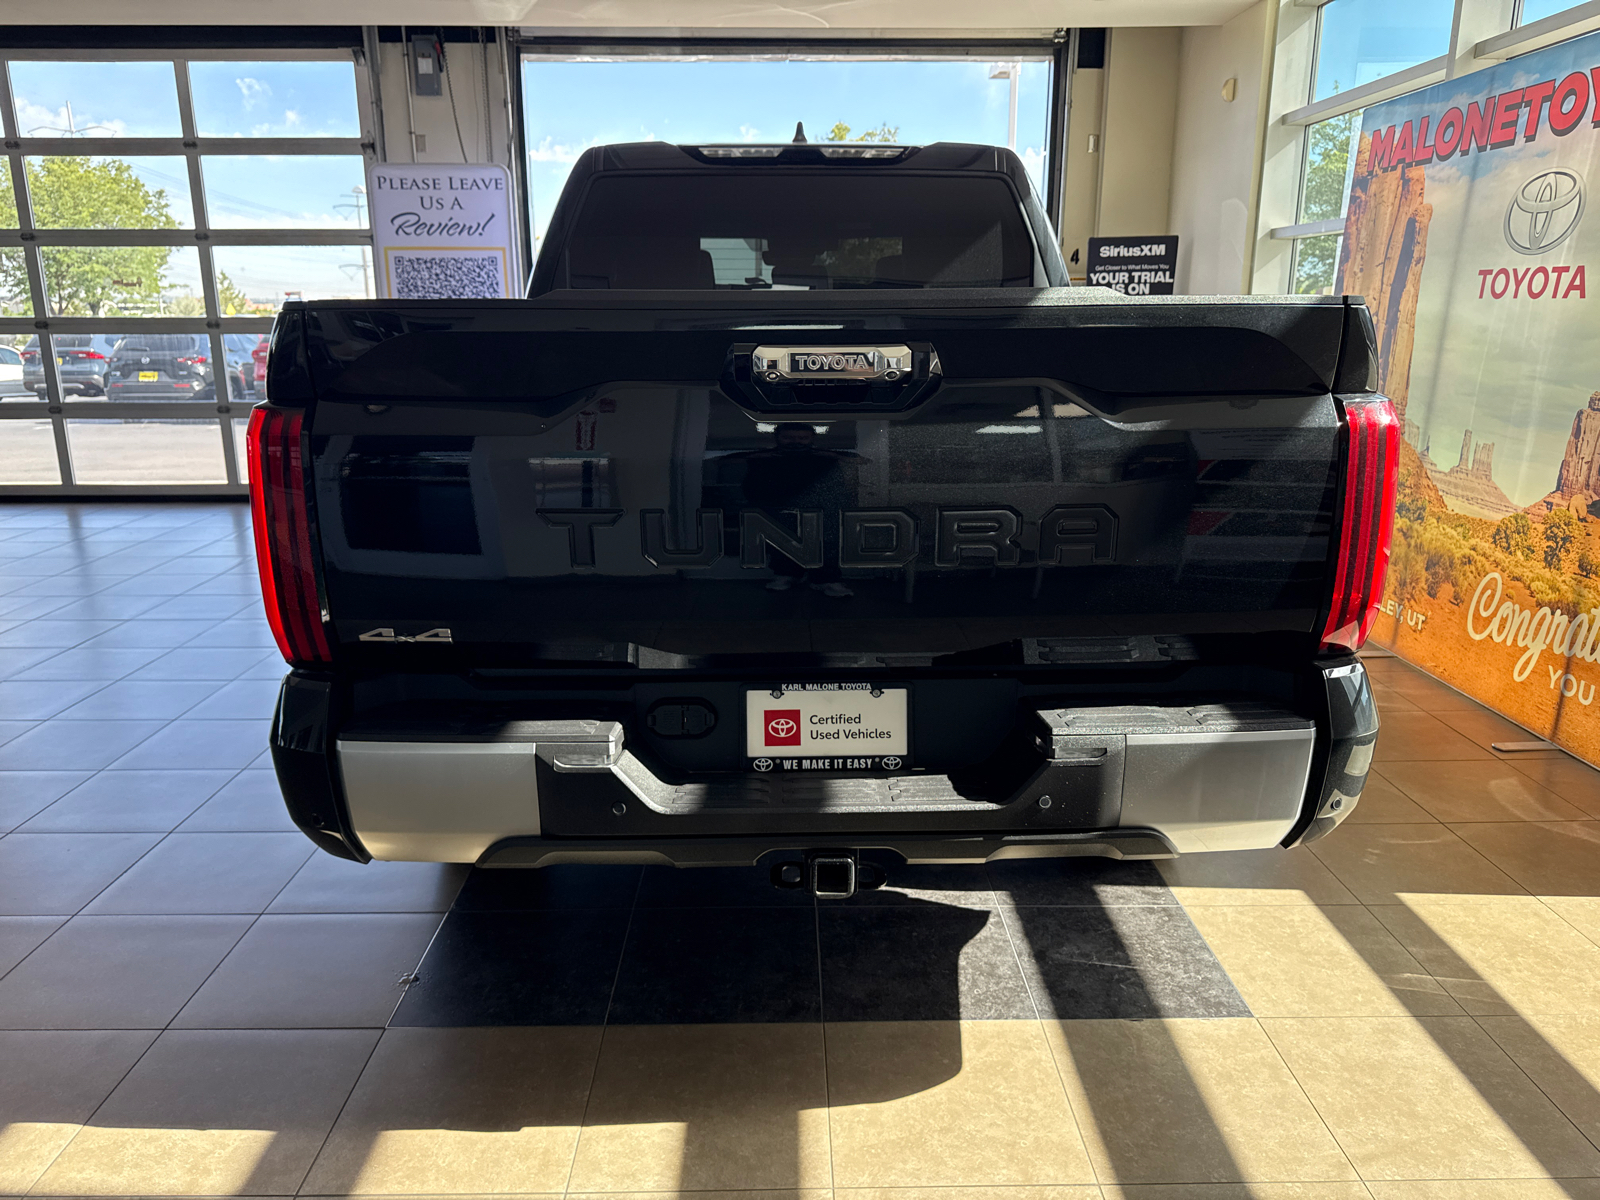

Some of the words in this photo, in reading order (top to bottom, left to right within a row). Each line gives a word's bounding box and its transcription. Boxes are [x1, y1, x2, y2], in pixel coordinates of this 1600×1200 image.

[1366, 66, 1600, 176] MALONETO
[376, 175, 442, 191] PLEASE
[448, 176, 504, 191] LEAVE
[419, 195, 445, 210] US
[450, 196, 465, 210] A
[390, 211, 496, 237] Review!
[1071, 249, 1079, 264] 4
[1100, 244, 1165, 257] SiriusXM
[1089, 271, 1130, 284] YOUR
[1131, 270, 1174, 284] TRIAL
[1478, 265, 1586, 300] TOYOTA
[1127, 283, 1151, 295] ON
[795, 354, 870, 371] TOYOTA
[535, 503, 1120, 569] TUNDRA
[1407, 608, 1426, 631] UT
[781, 683, 803, 691] KARL
[805, 683, 839, 691] MALONE
[840, 682, 872, 691] TOYOTA
[1548, 665, 1596, 706] YOU
[809, 713, 862, 725] Certified
[810, 729, 840, 740] Used
[842, 728, 892, 740] Vehicles
[783, 759, 799, 770] WE
[802, 759, 830, 770] MAKE
[834, 759, 843, 769] IT
[846, 758, 873, 769] EASY
